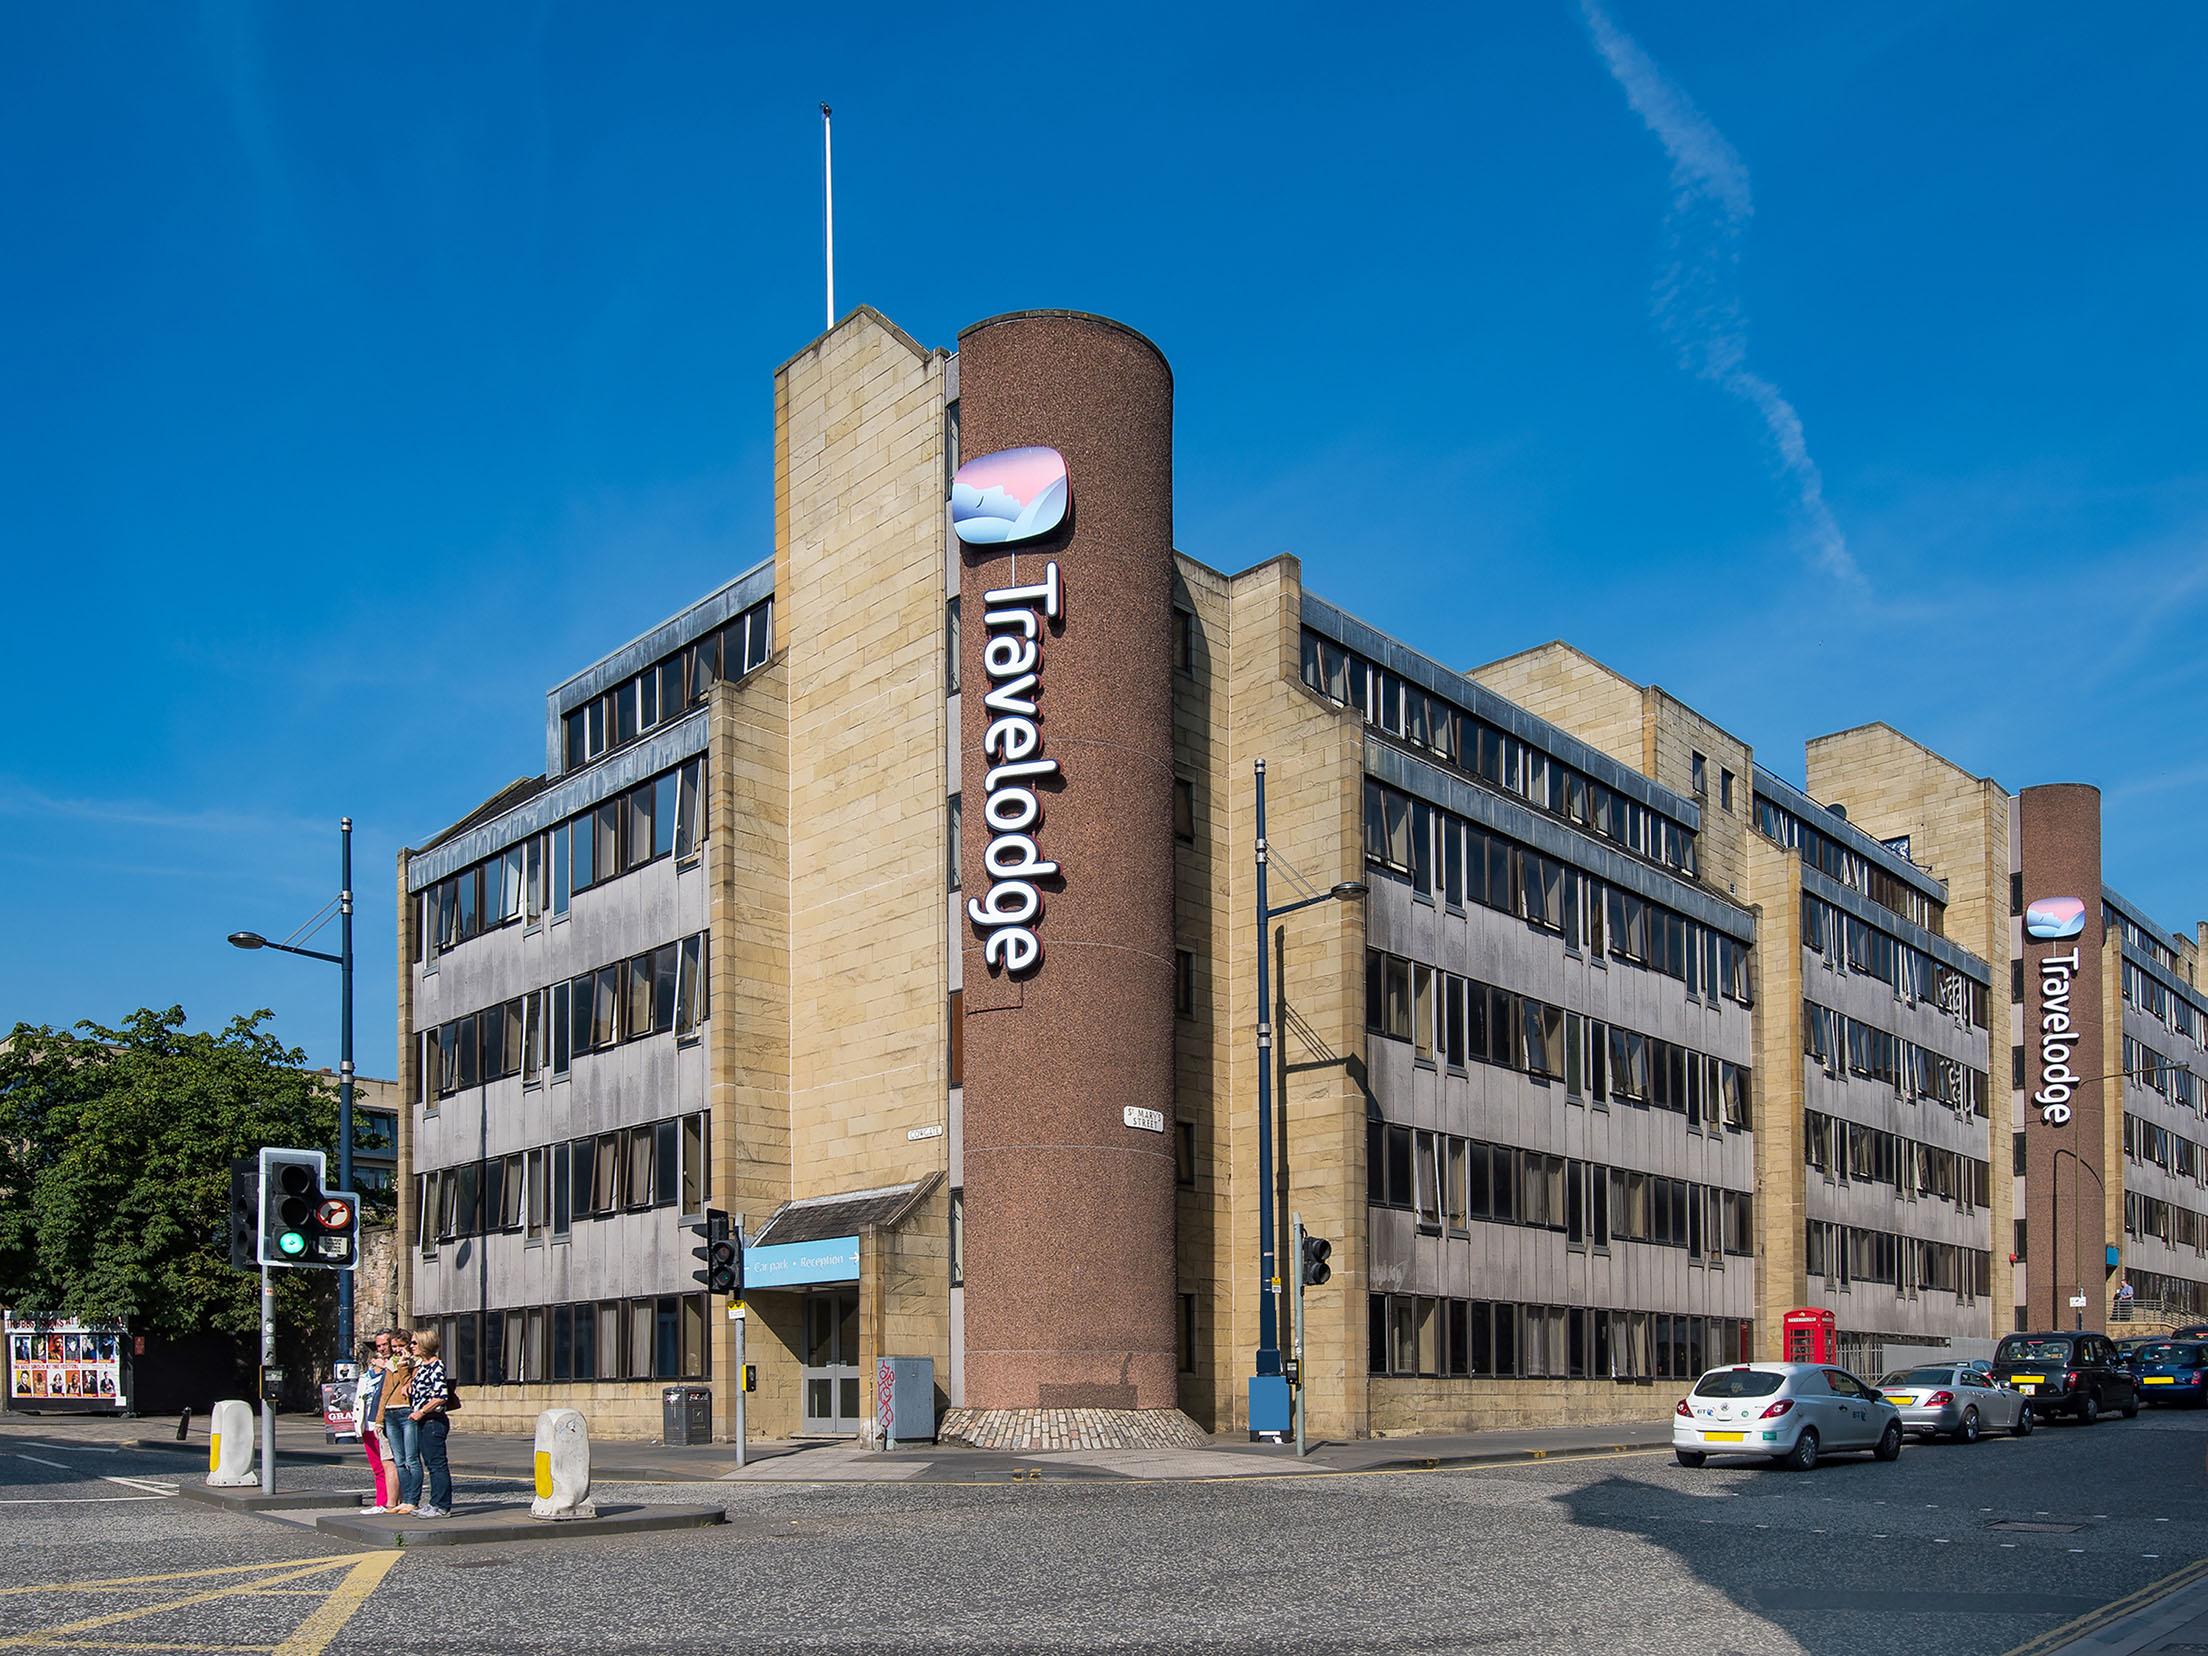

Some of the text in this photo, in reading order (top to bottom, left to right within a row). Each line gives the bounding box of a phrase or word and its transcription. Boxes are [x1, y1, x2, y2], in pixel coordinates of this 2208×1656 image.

[968, 561, 1059, 971] Travelodge
[2035, 946, 2080, 1123] Travelodge
[1133, 1117, 1158, 1129] STREET
[753, 1255, 844, 1273] Car park Reception
[328, 1411, 353, 1421] GRA
